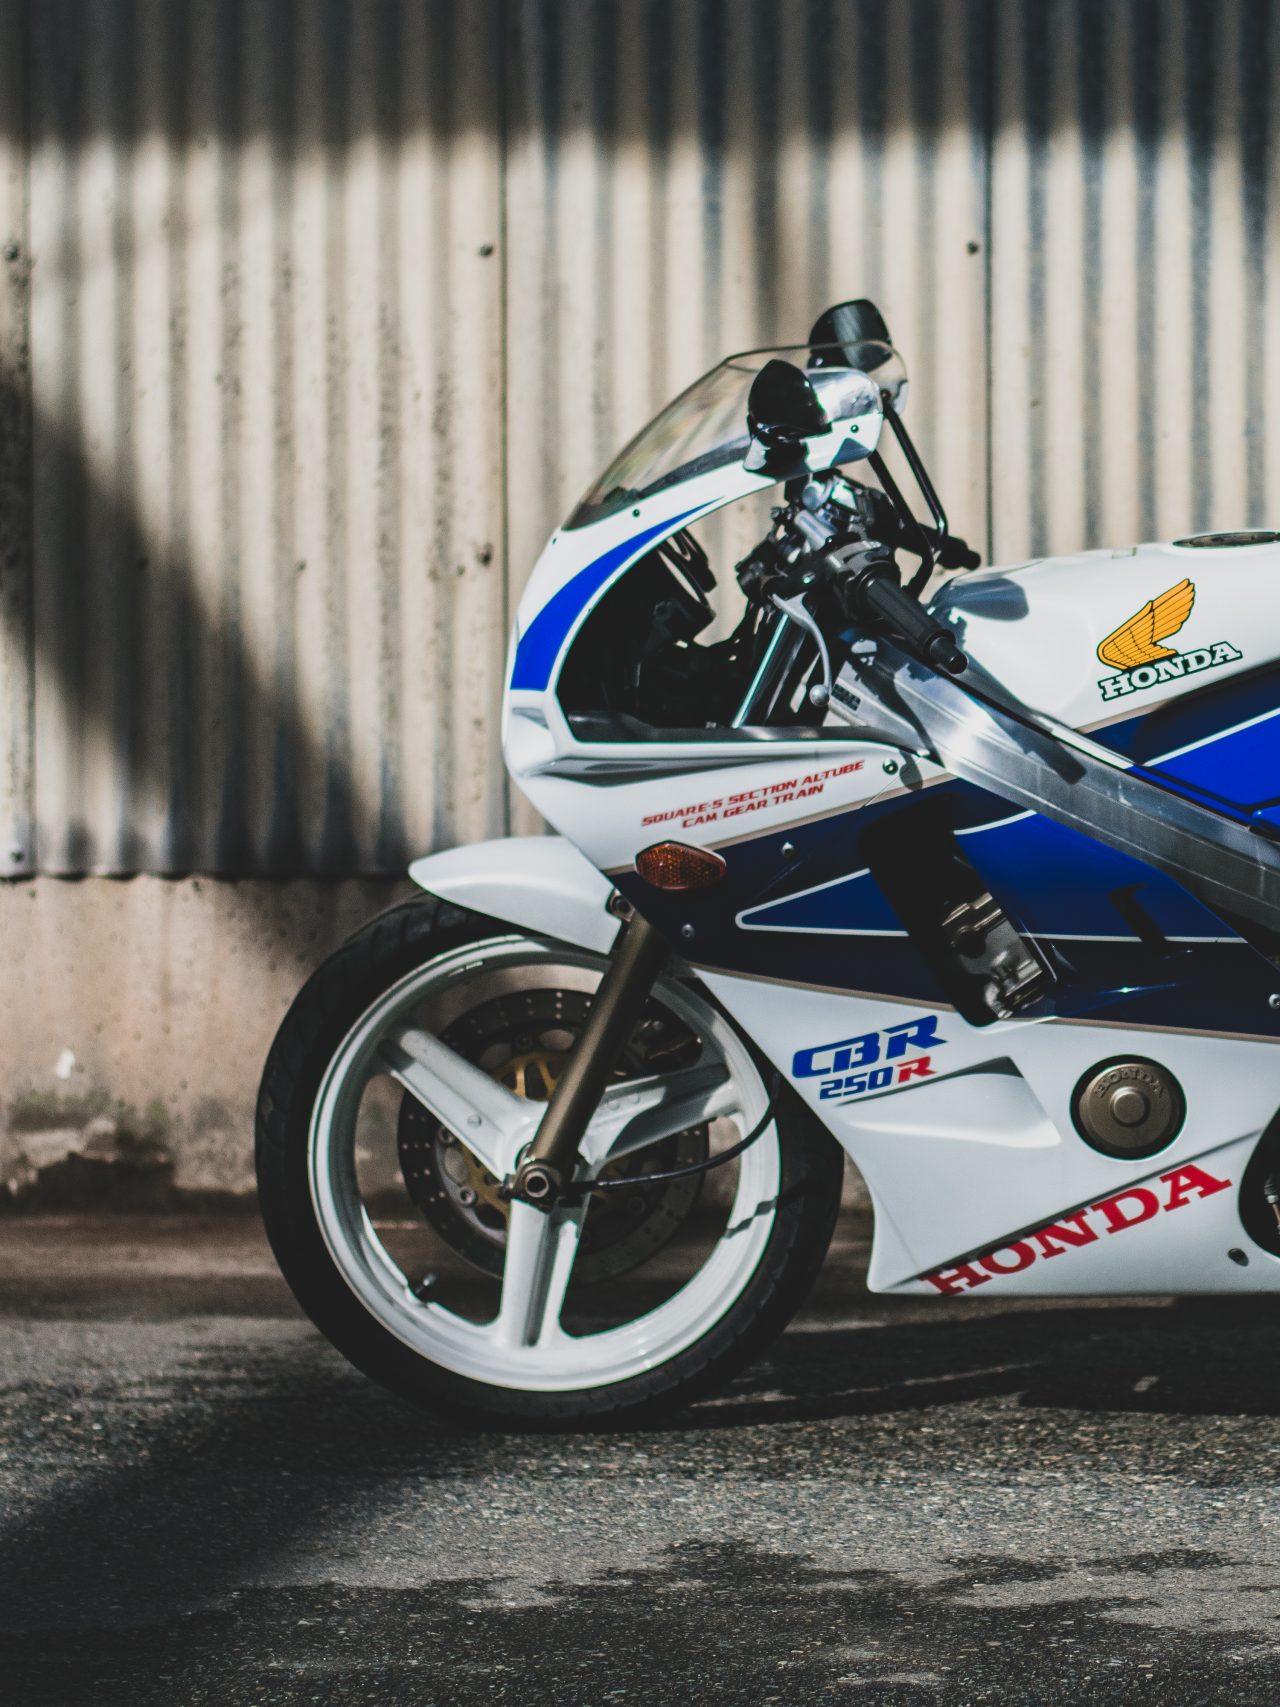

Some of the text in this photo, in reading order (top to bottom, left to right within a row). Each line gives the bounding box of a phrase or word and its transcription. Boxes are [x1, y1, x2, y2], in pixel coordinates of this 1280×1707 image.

[1098, 641, 1243, 702] HONDA
[681, 783, 824, 829] CAM GEAR TRAIN
[726, 779, 799, 806] SECTION
[792, 1014, 948, 1078] CBR
[917, 1163, 1233, 1297] HONDA
